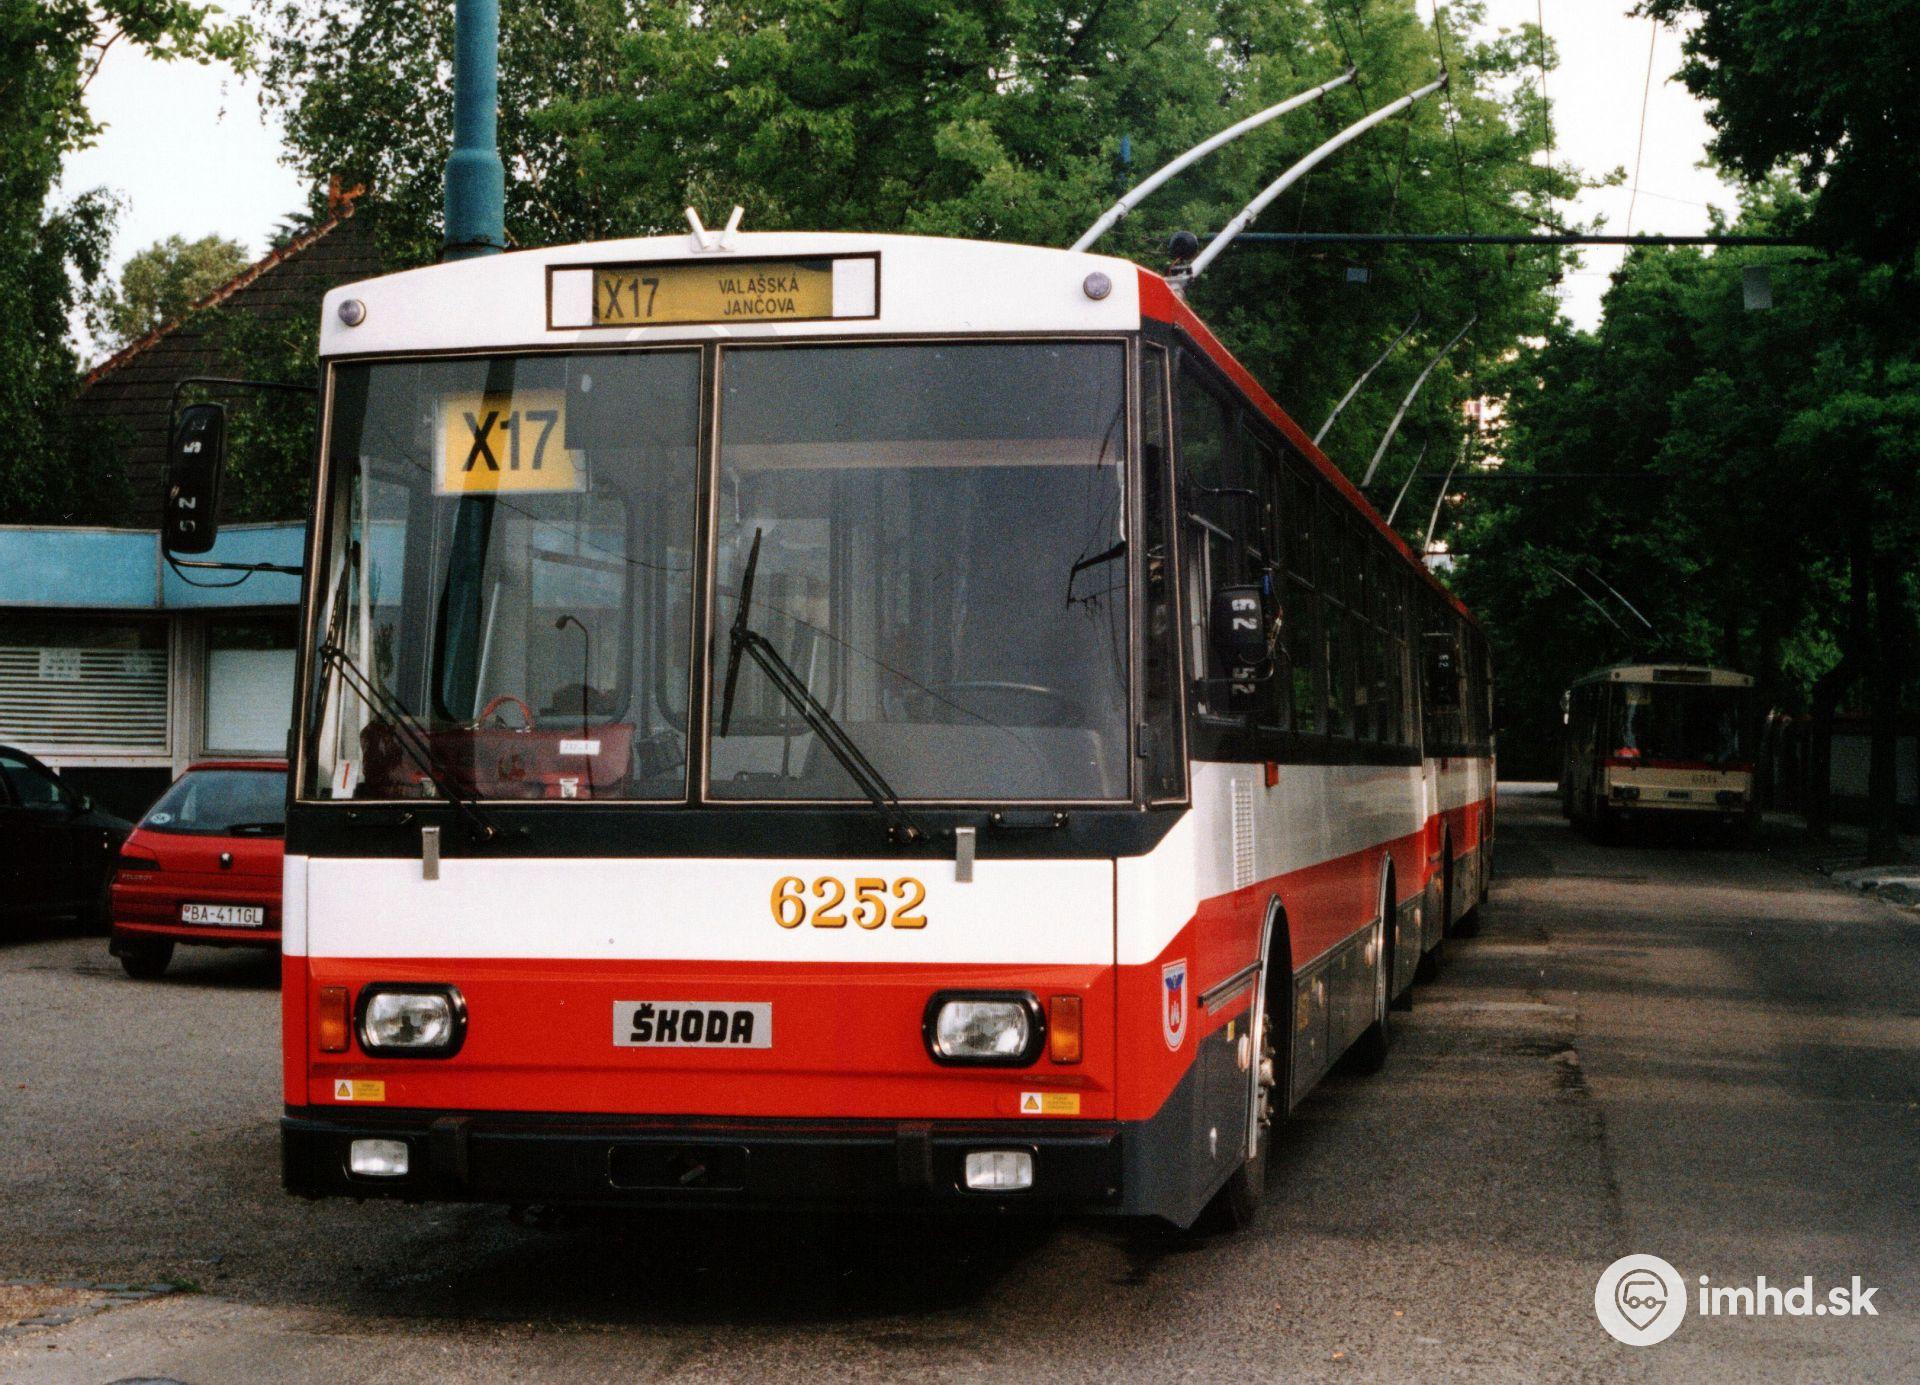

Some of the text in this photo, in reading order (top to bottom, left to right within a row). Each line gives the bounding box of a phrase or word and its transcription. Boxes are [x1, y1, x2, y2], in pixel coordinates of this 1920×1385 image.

[604, 277, 660, 318] X17
[718, 270, 800, 295] VALAŠSKÁ
[723, 295, 796, 316] JANČOVA
[461, 409, 559, 472] X17
[190, 905, 261, 924] BA-411GL
[770, 875, 928, 930] 6252
[630, 1002, 754, 1044] ŠKODA
